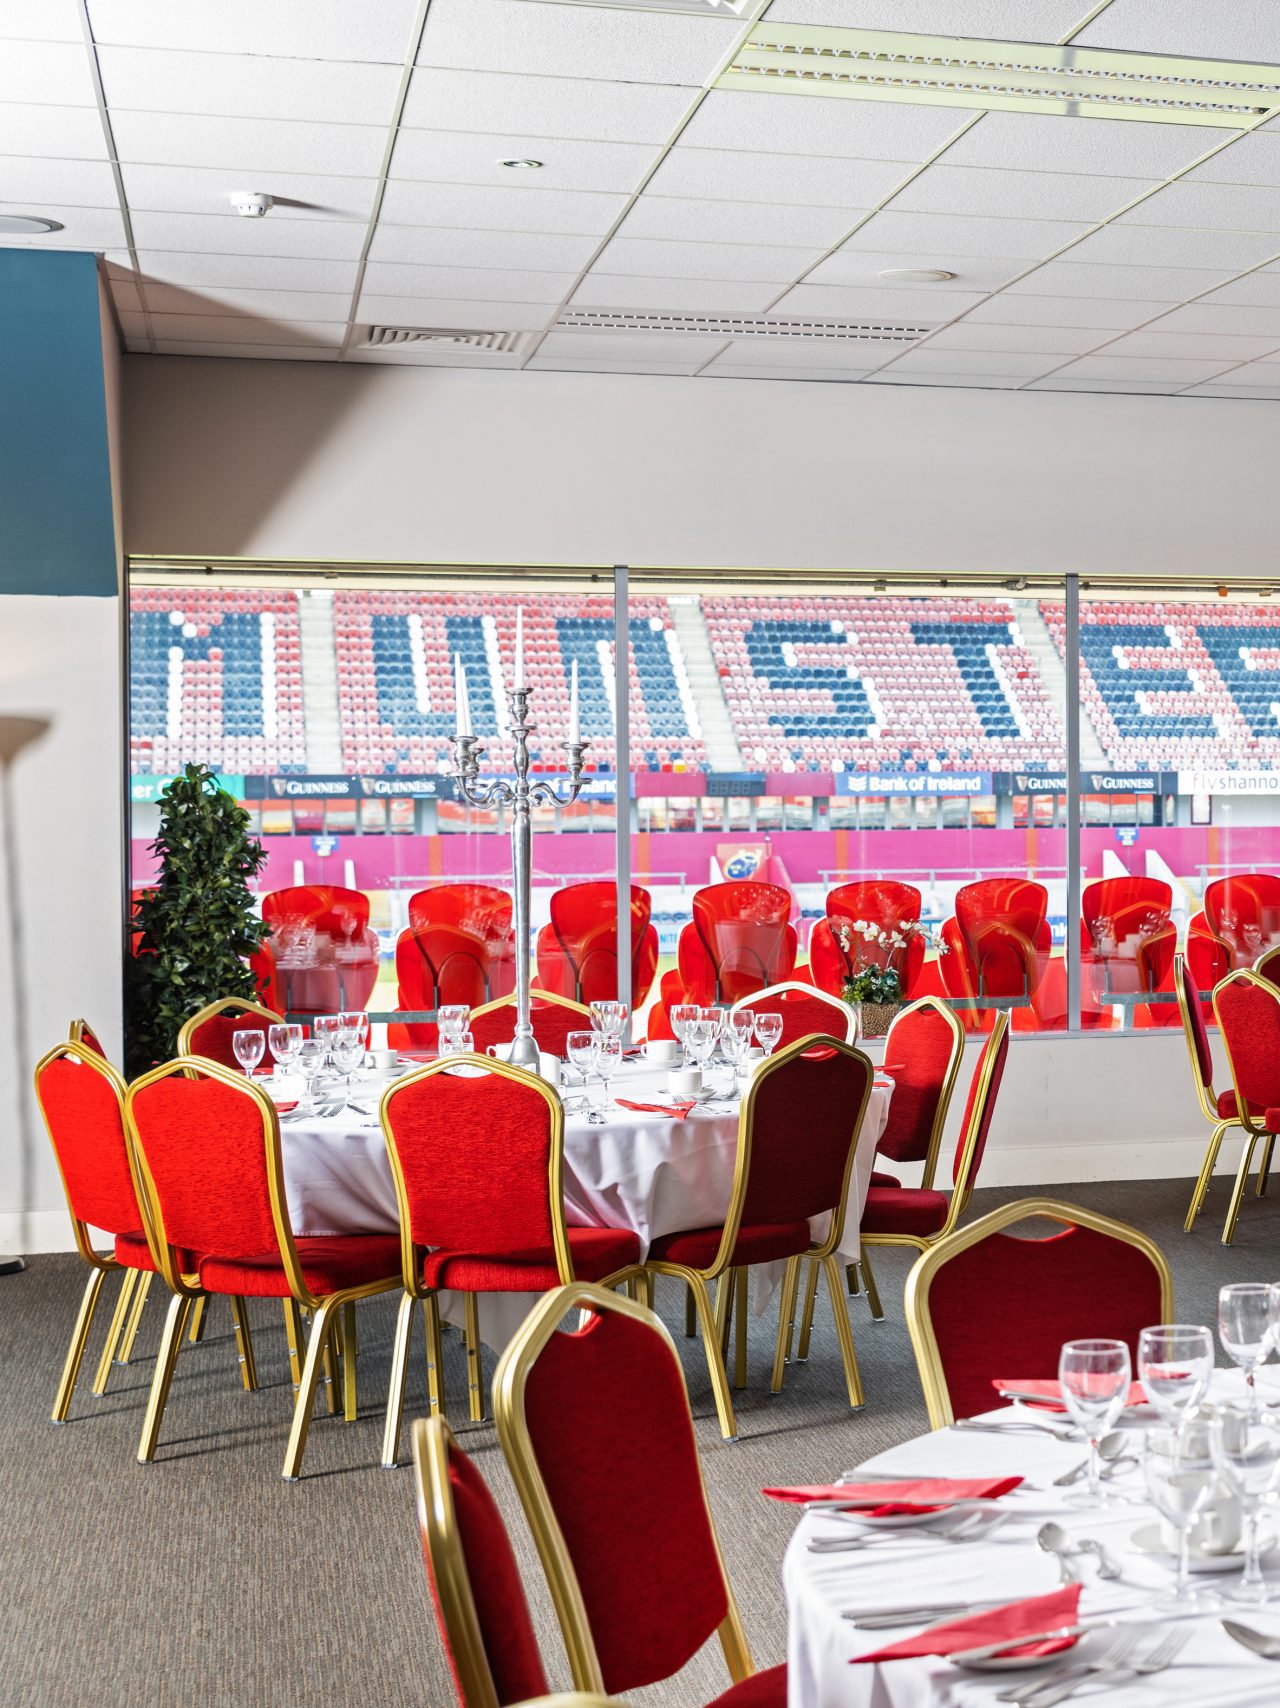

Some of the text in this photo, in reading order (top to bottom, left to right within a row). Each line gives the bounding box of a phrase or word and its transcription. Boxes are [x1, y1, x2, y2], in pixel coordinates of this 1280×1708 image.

[287, 779, 349, 795] GUINNESS
[375, 779, 436, 794] GUINNESS
[870, 775, 981, 791] Bank of Ireland
[1028, 777, 1067, 790] GUINN
[1102, 777, 1154, 790] GUINNESS
